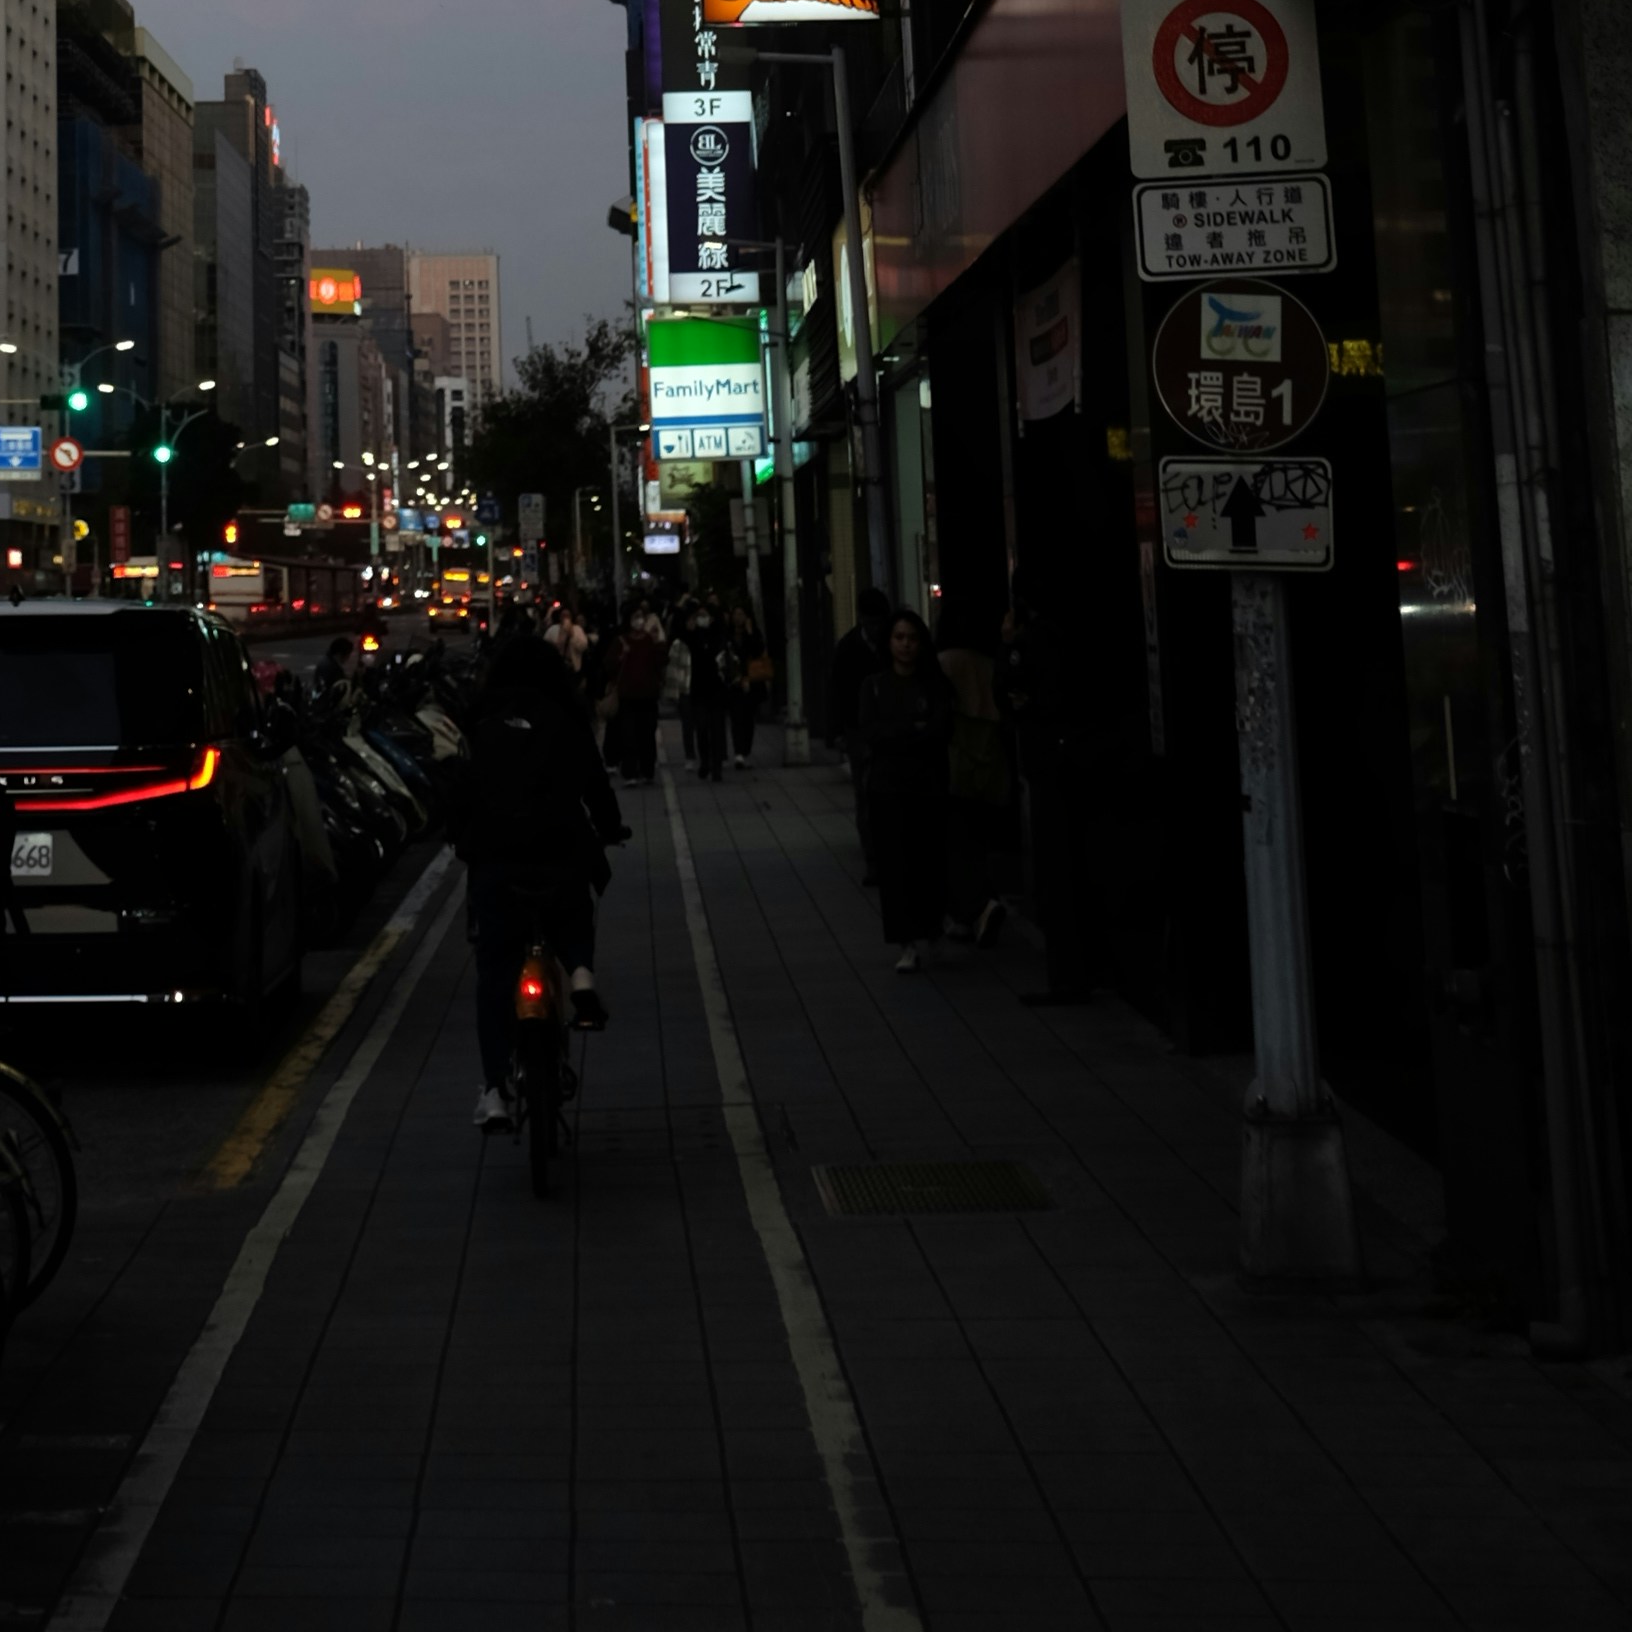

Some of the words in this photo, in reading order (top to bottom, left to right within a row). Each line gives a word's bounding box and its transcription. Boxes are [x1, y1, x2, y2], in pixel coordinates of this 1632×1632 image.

[1188, 24, 1256, 96] 停
[694, 97, 722, 117] 3F
[1223, 134, 1292, 163] 110
[1194, 208, 1295, 228] SIDEWALK
[1165, 250, 1256, 269] TOW-AWAY
[1262, 248, 1308, 264] ZONE
[653, 378, 760, 402] FamilyMart
[697, 434, 723, 452] ATM
[12, 844, 51, 869] 668
